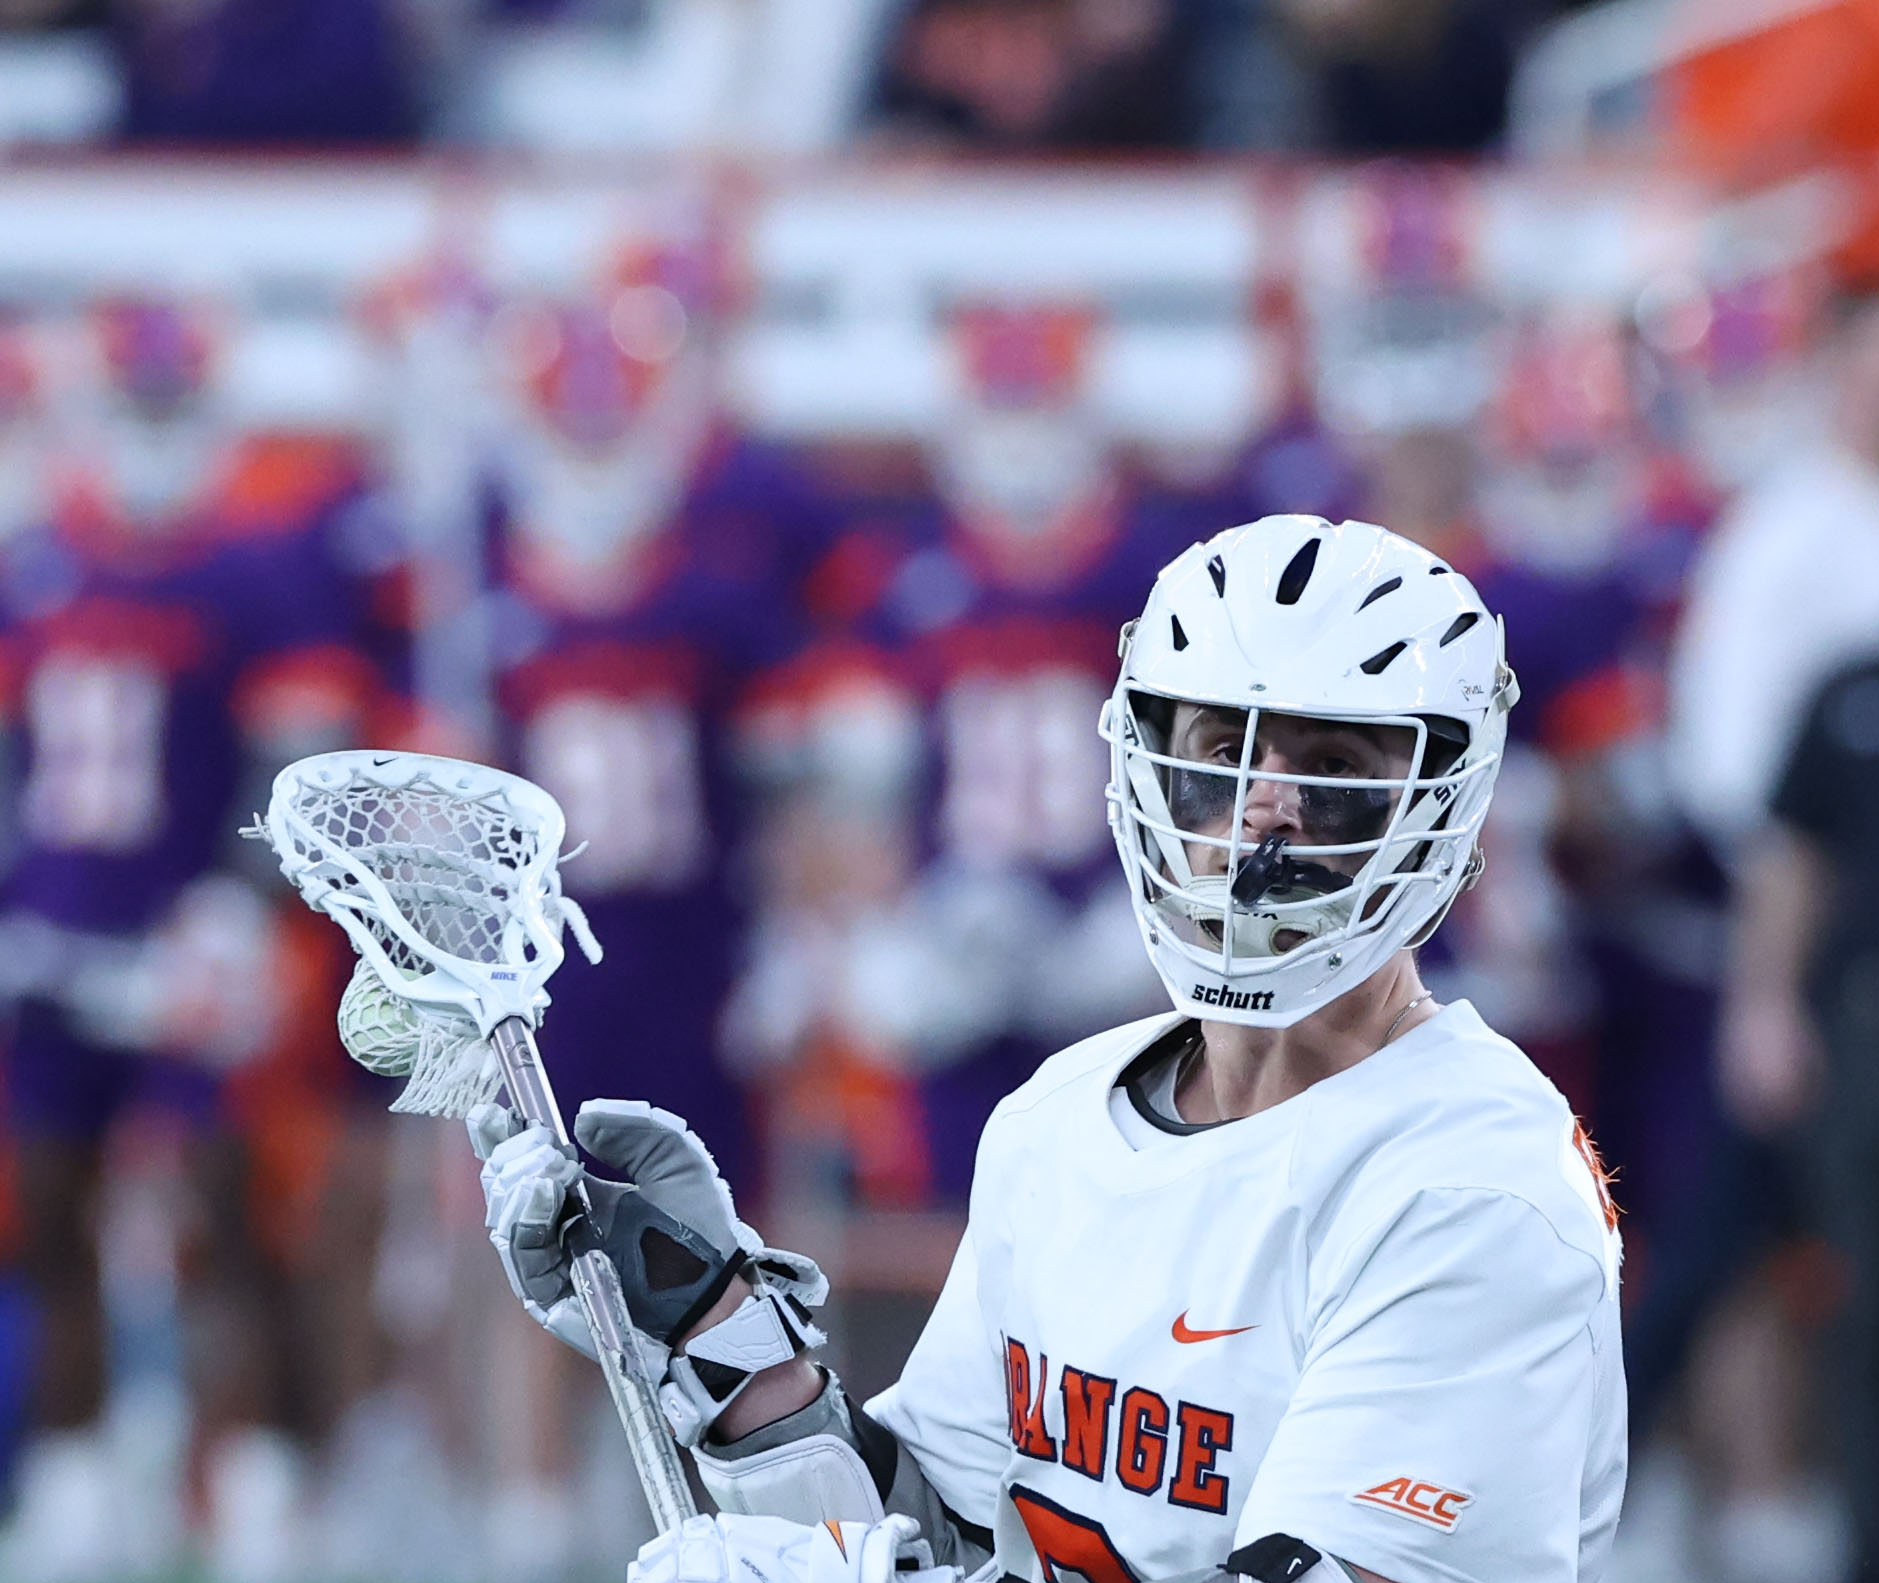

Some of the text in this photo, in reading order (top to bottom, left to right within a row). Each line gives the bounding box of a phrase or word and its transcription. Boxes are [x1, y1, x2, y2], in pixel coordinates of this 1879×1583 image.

[491, 971, 518, 981] NIKE
[1191, 984, 1275, 1010] schutt
[1001, 1330, 1234, 1516] RANGE
[1363, 1477, 1470, 1522] ACC
